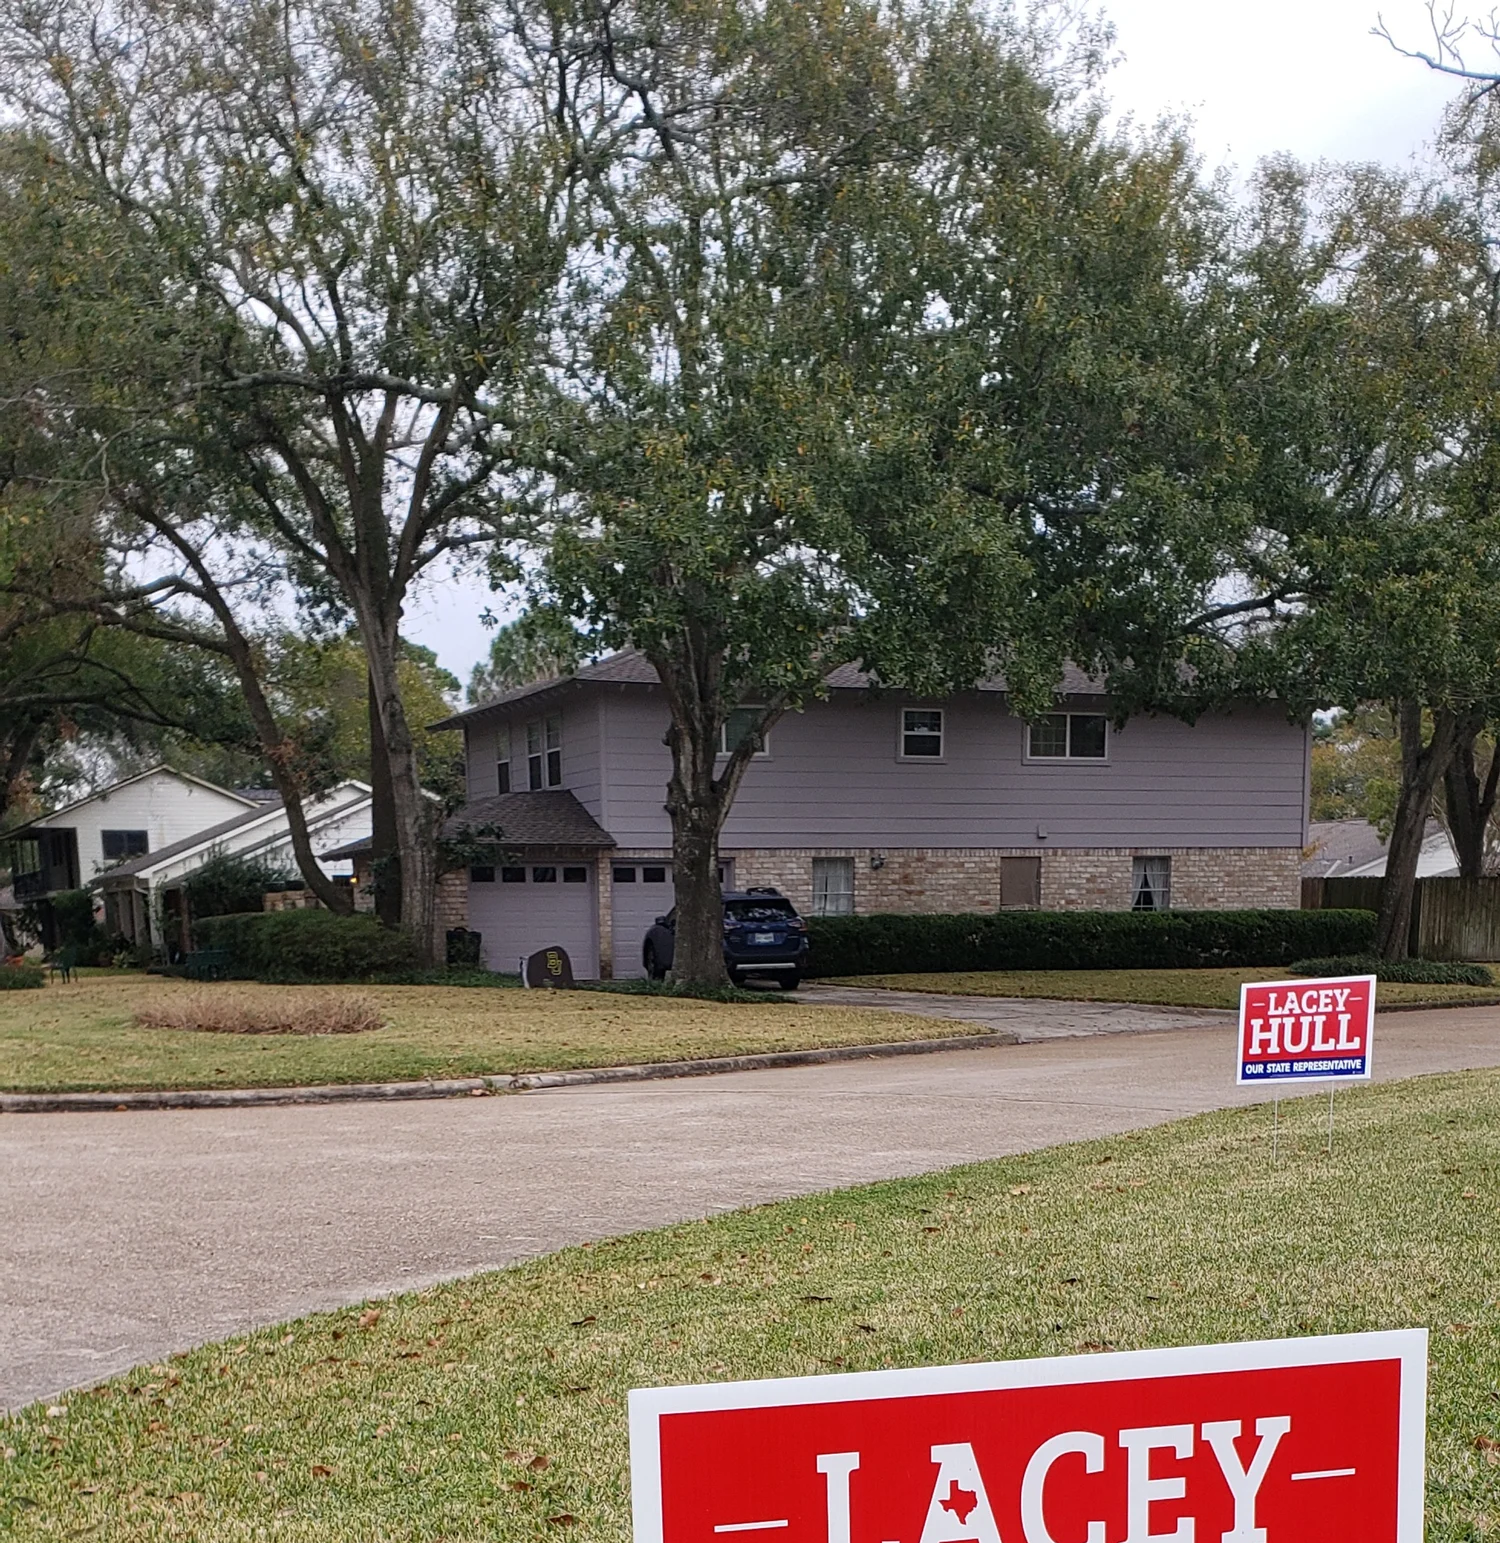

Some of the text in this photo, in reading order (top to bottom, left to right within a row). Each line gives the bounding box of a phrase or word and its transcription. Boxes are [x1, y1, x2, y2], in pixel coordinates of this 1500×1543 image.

[1268, 989, 1351, 1016] LACEY
[1248, 1014, 1361, 1055] HULL
[1245, 1059, 1362, 1074] OUR STATE REPRESENTATIVE
